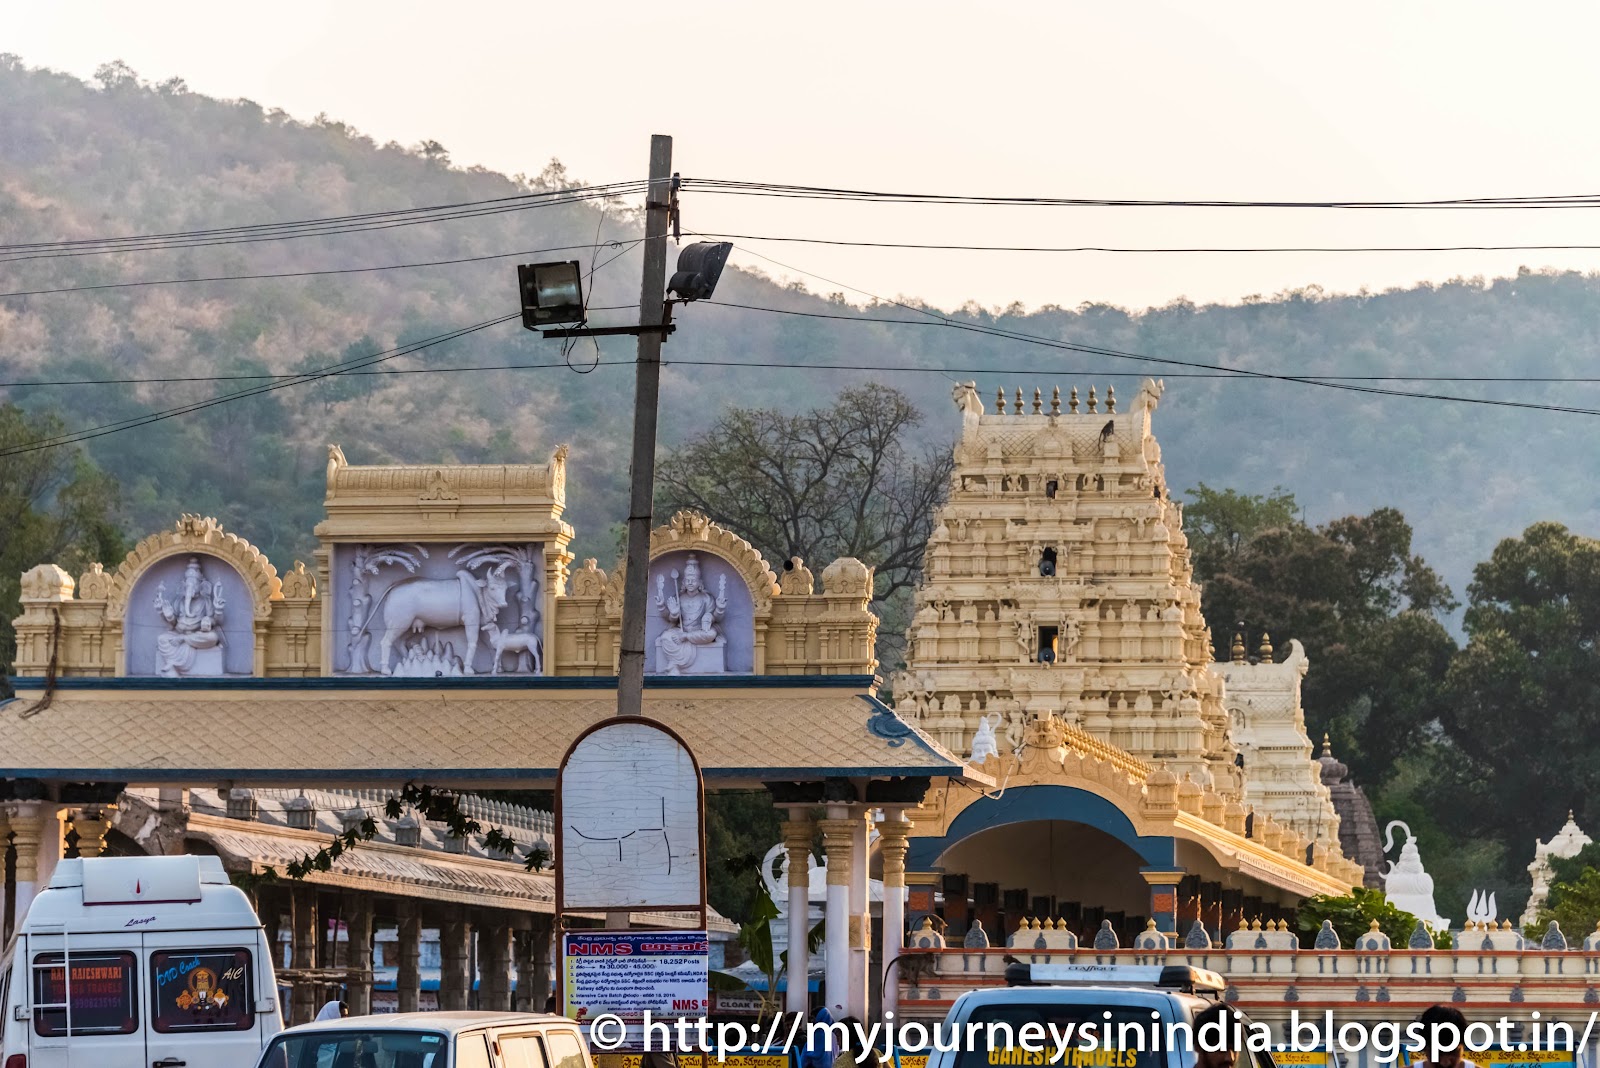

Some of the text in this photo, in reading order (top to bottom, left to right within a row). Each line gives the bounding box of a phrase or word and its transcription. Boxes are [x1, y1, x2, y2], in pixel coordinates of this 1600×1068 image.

[124, 916, 157, 927] Lasya
[569, 943, 634, 957] NMS
[51, 967, 69, 981] RAJ
[157, 966, 178, 987] DVD
[179, 954, 201, 975] Coach
[672, 1000, 699, 1012] NMS
[720, 1001, 750, 1009] CLOAK
[988, 1045, 1138, 1068] GANESH TRAVELS
